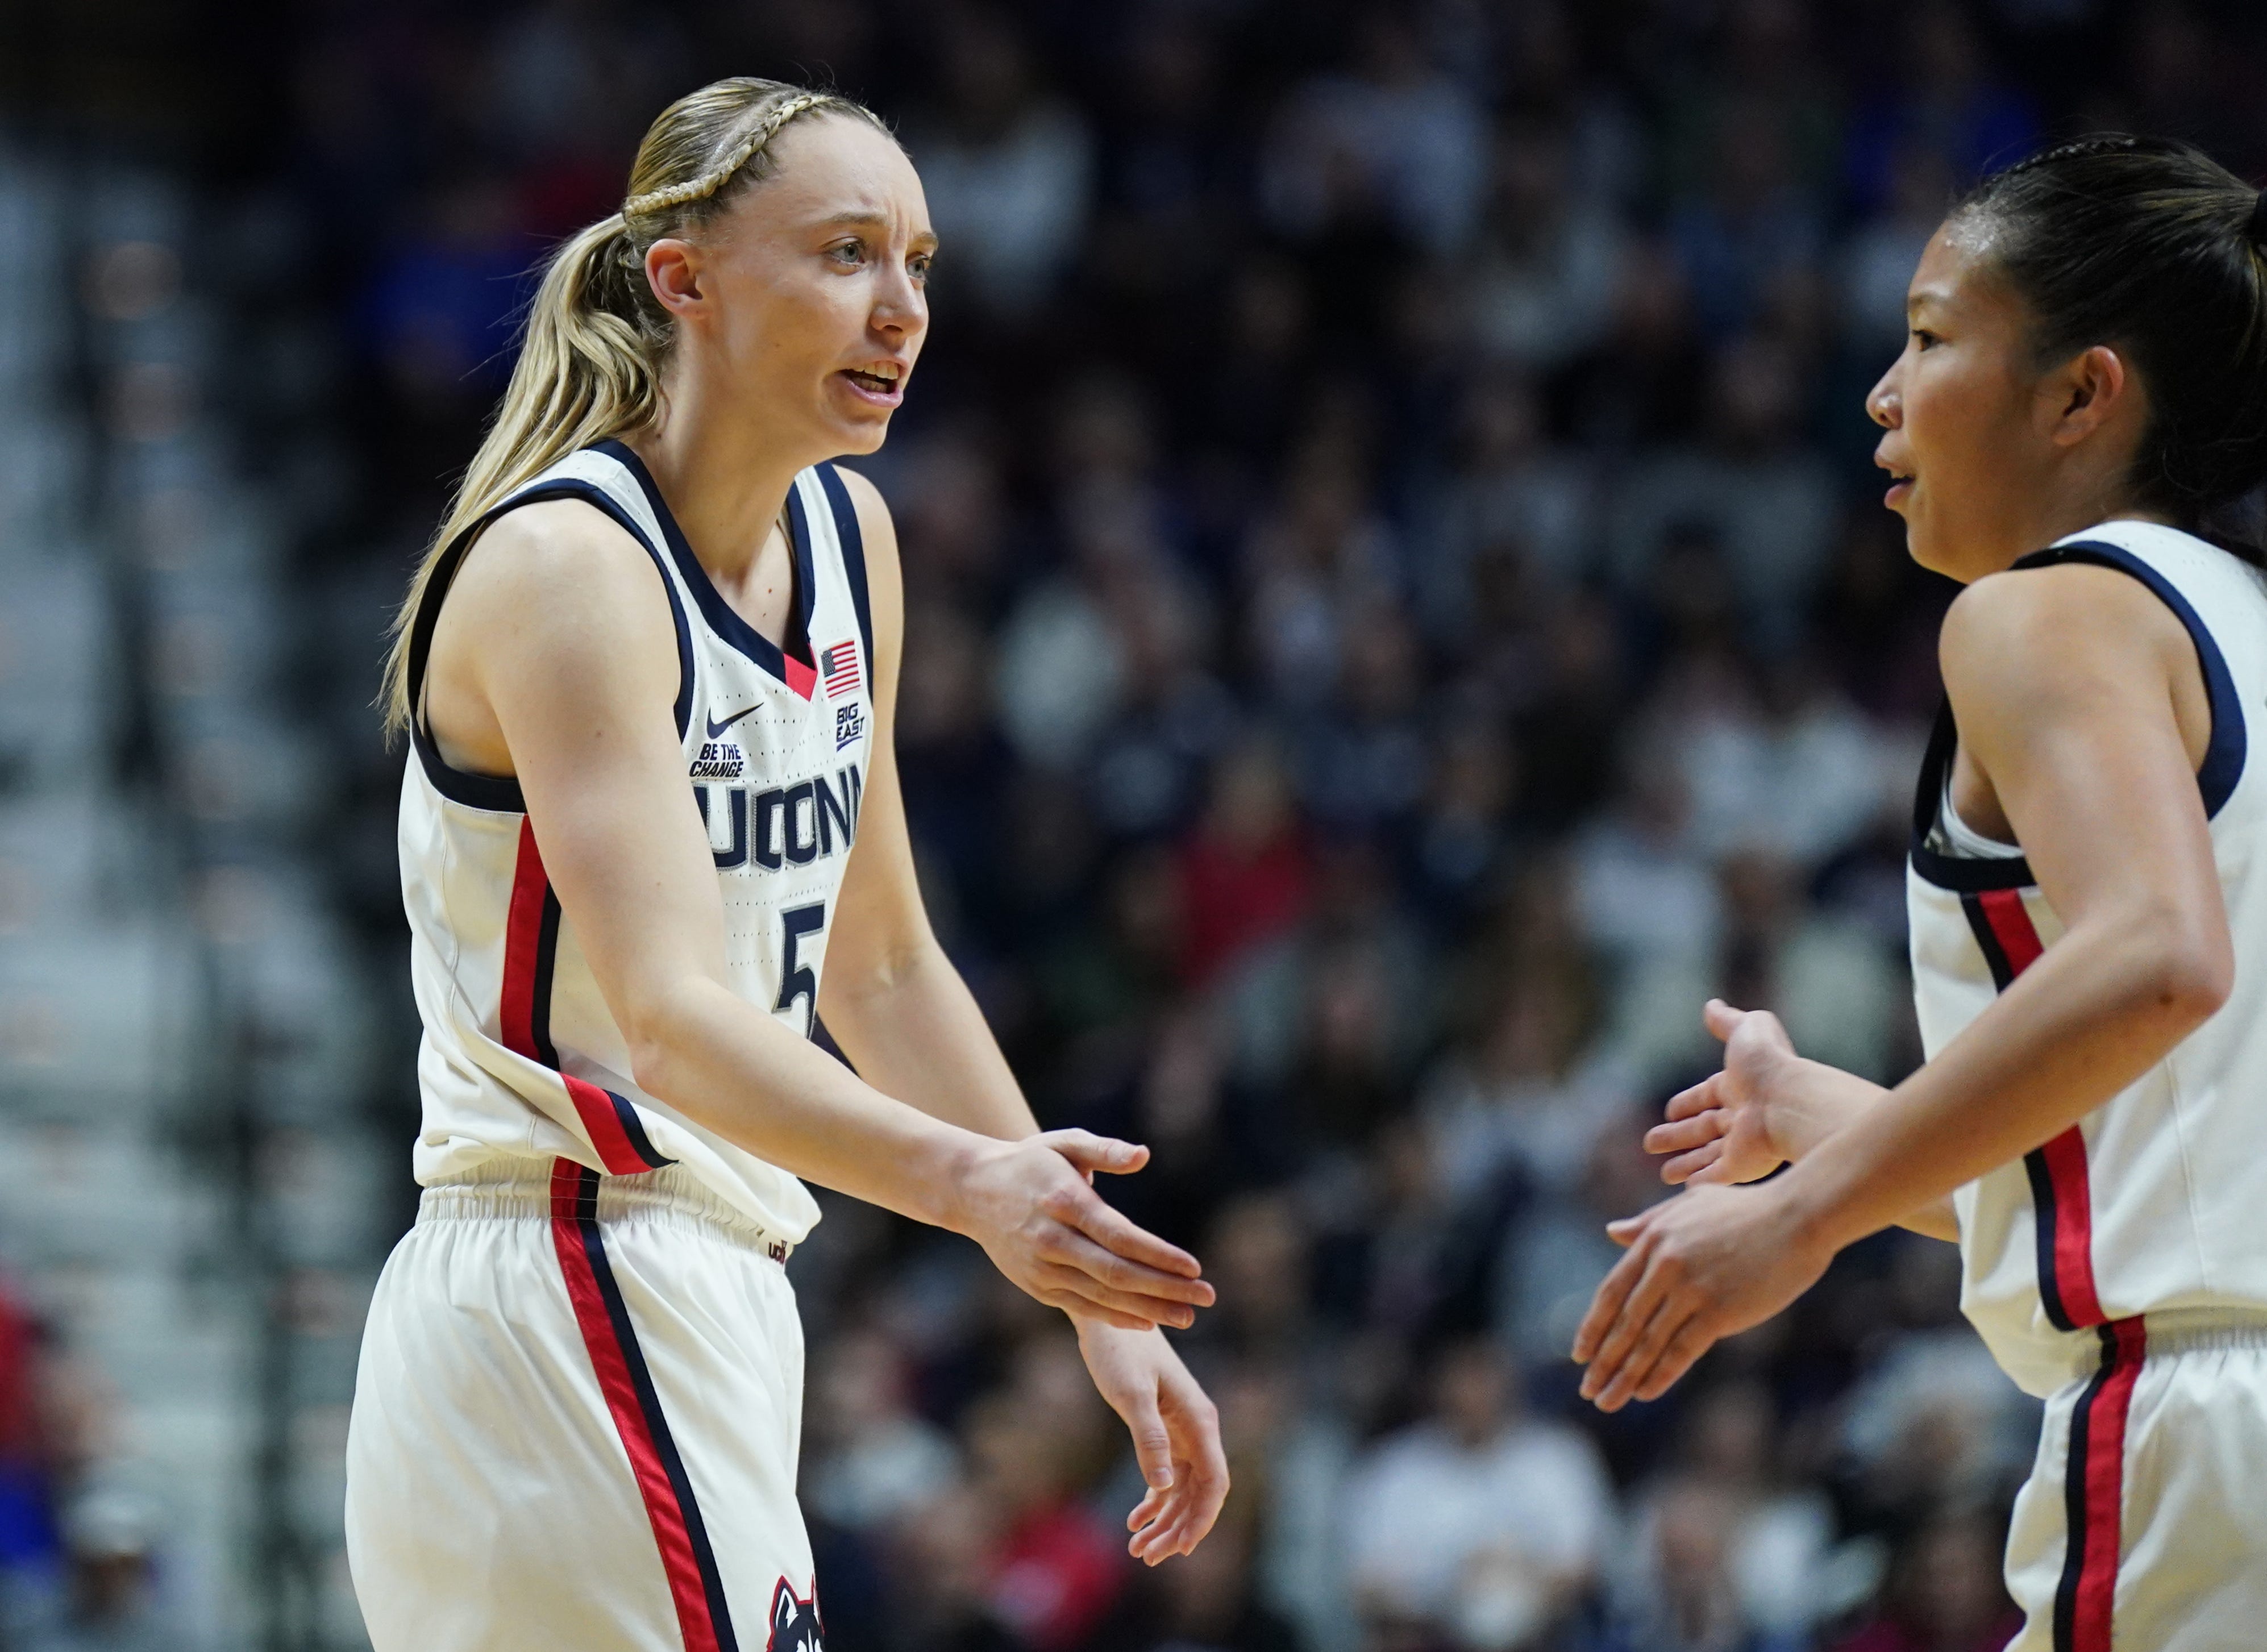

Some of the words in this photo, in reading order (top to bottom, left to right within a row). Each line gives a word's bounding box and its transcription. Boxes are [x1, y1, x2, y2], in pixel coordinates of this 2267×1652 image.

[837, 702, 858, 725] BIG
[837, 715, 865, 742] EAST
[699, 743, 718, 760] BE
[720, 744, 741, 760] THE
[689, 760, 744, 777] CHANGE
[771, 899, 825, 1041] 5
